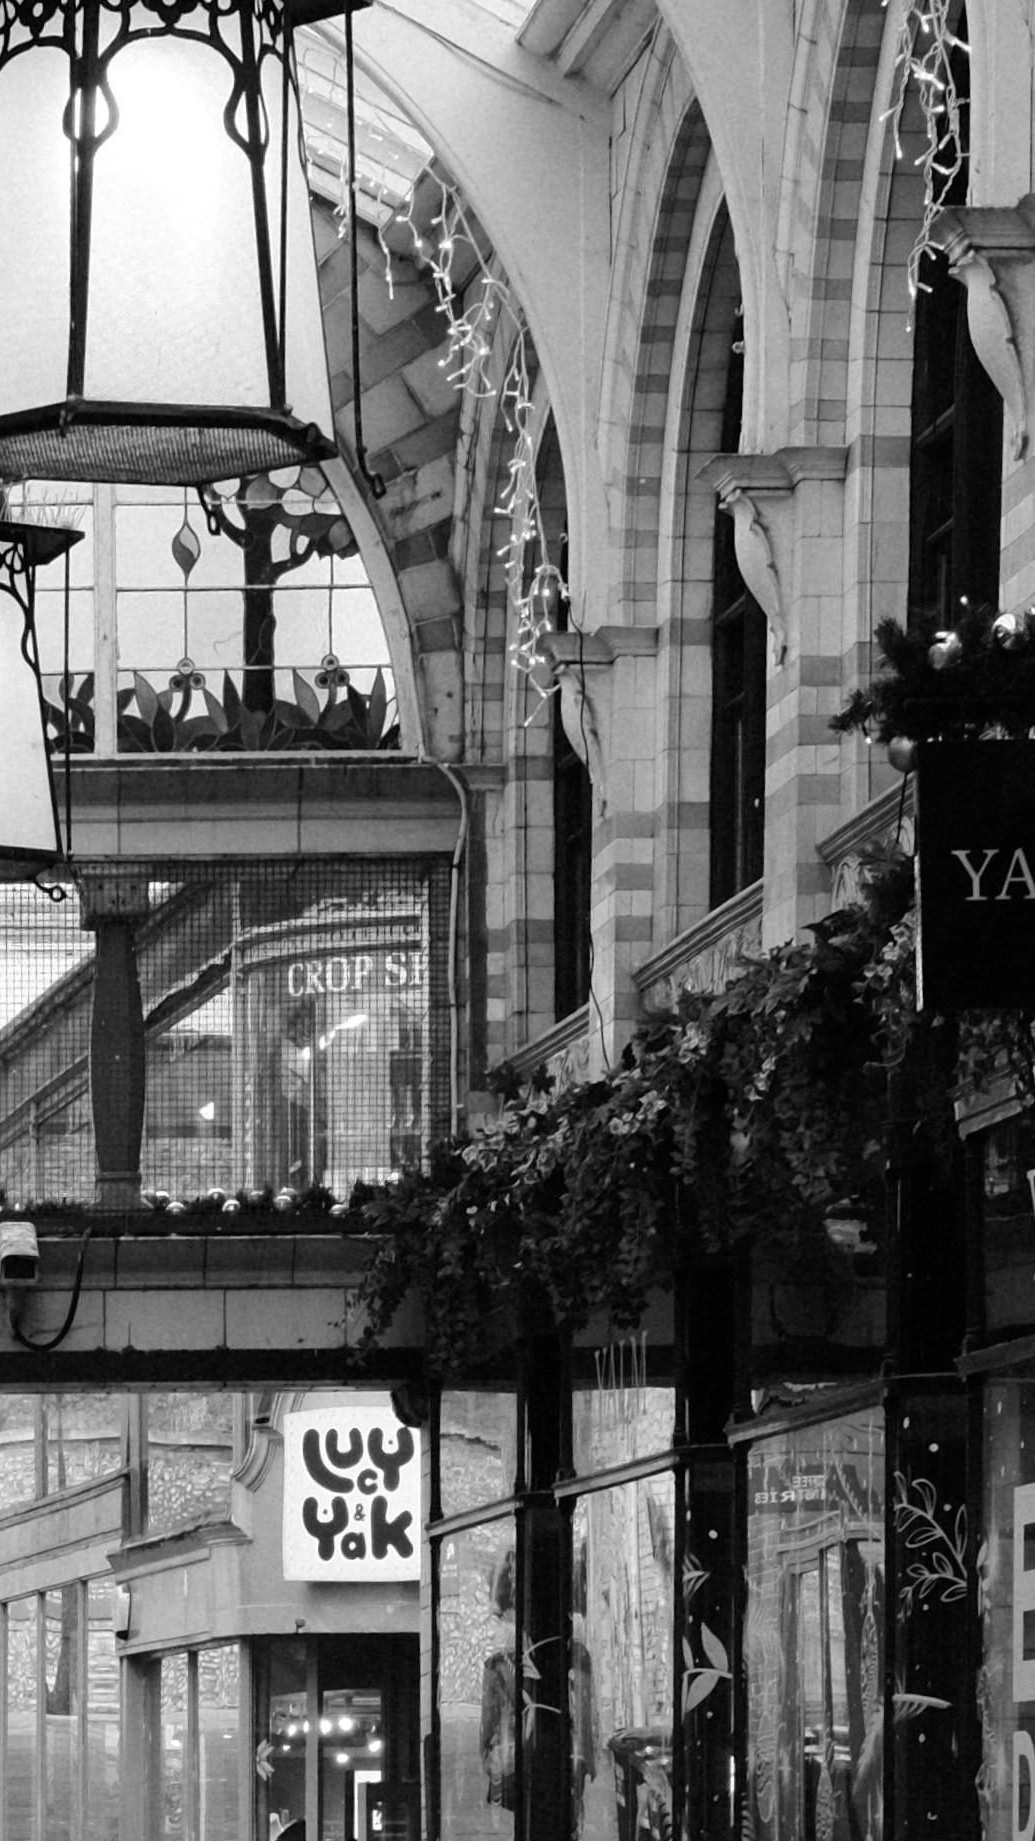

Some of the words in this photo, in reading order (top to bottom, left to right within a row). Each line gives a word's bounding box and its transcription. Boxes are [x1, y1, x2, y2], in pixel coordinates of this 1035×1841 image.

[951, 848, 1035, 900] YA
[288, 955, 374, 996] CROP
[303, 1495, 414, 1561] Yak
[354, 1503, 366, 1521] &
